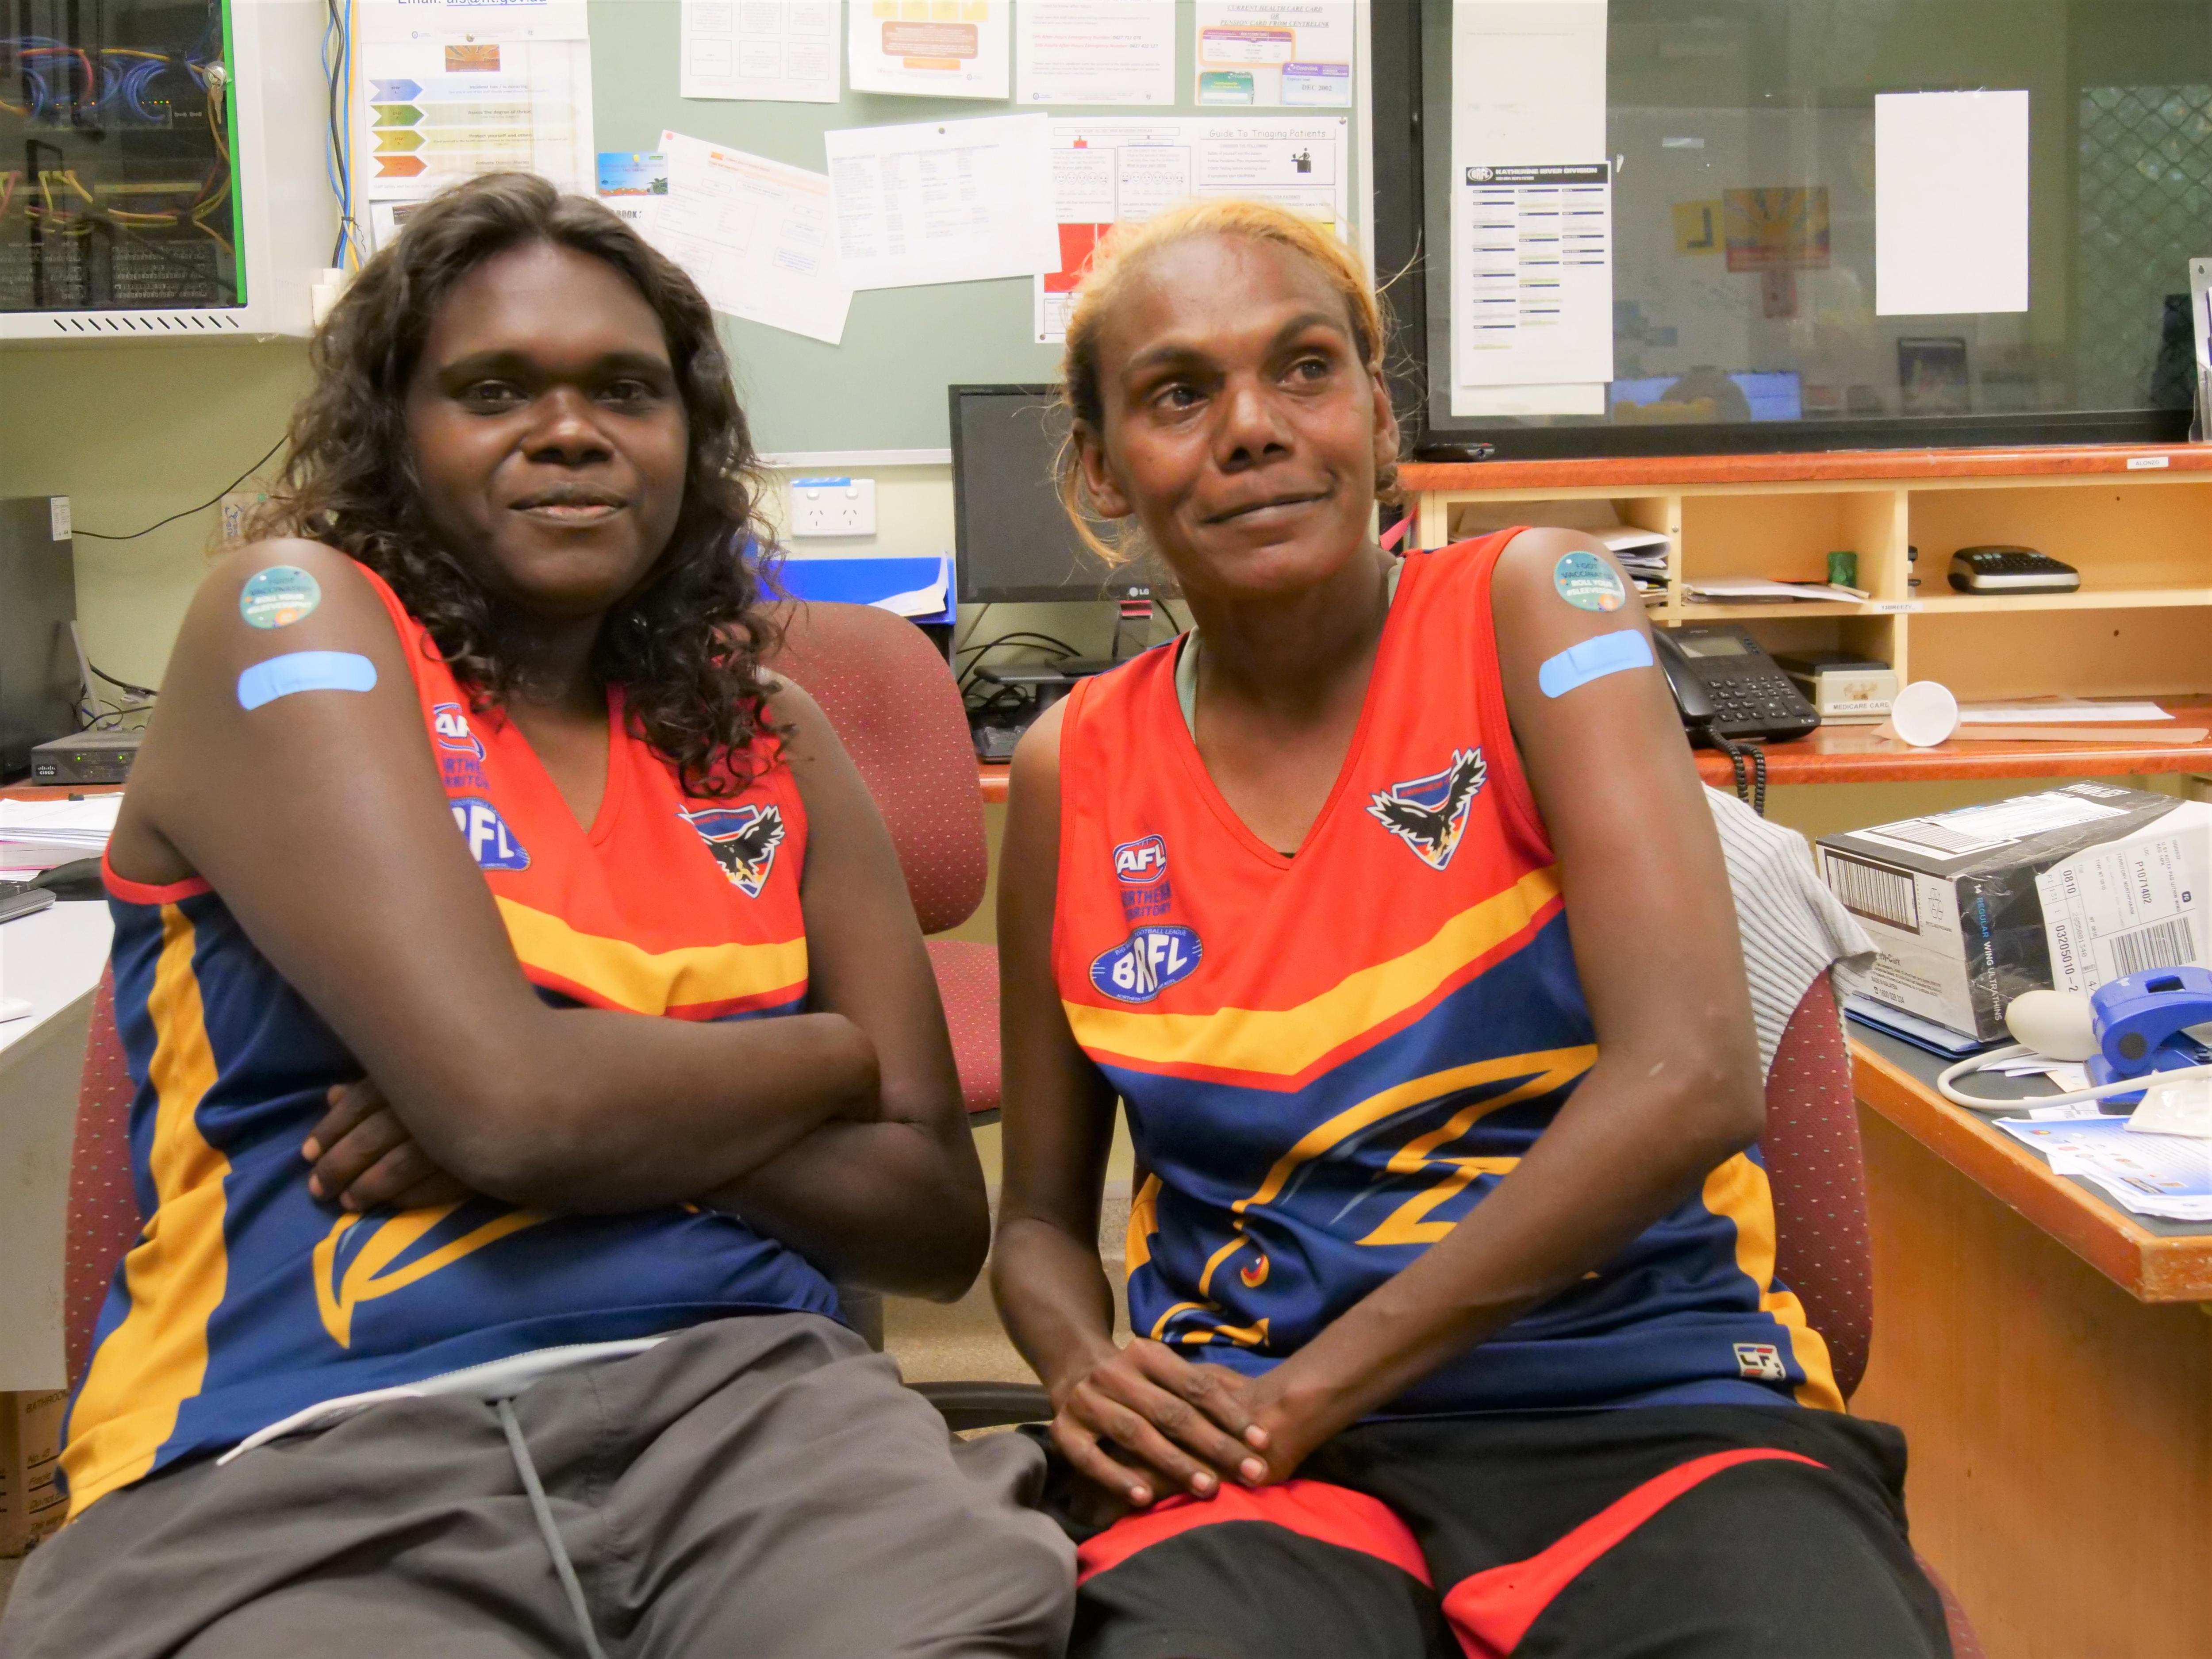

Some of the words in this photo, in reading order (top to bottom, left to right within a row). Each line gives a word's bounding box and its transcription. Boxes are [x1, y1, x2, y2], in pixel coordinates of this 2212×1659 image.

[1209, 128, 1234, 138] Guide
[1237, 129, 1248, 138] To
[1251, 129, 1287, 140] Triaging
[1289, 128, 1326, 138] Patients
[1117, 844, 1166, 874] AFL
[1974, 883, 1982, 894] 14
[2062, 869, 2077, 895] 0810
[2116, 853, 2127, 879] TERRITORY
[2123, 880, 2135, 915] NORTHPHARM
[2135, 860, 2153, 905] P1071402
[1976, 897, 1990, 938] REGULAR
[1983, 941, 1994, 966] WING
[1988, 968, 2002, 1021] ULTRATHINS
